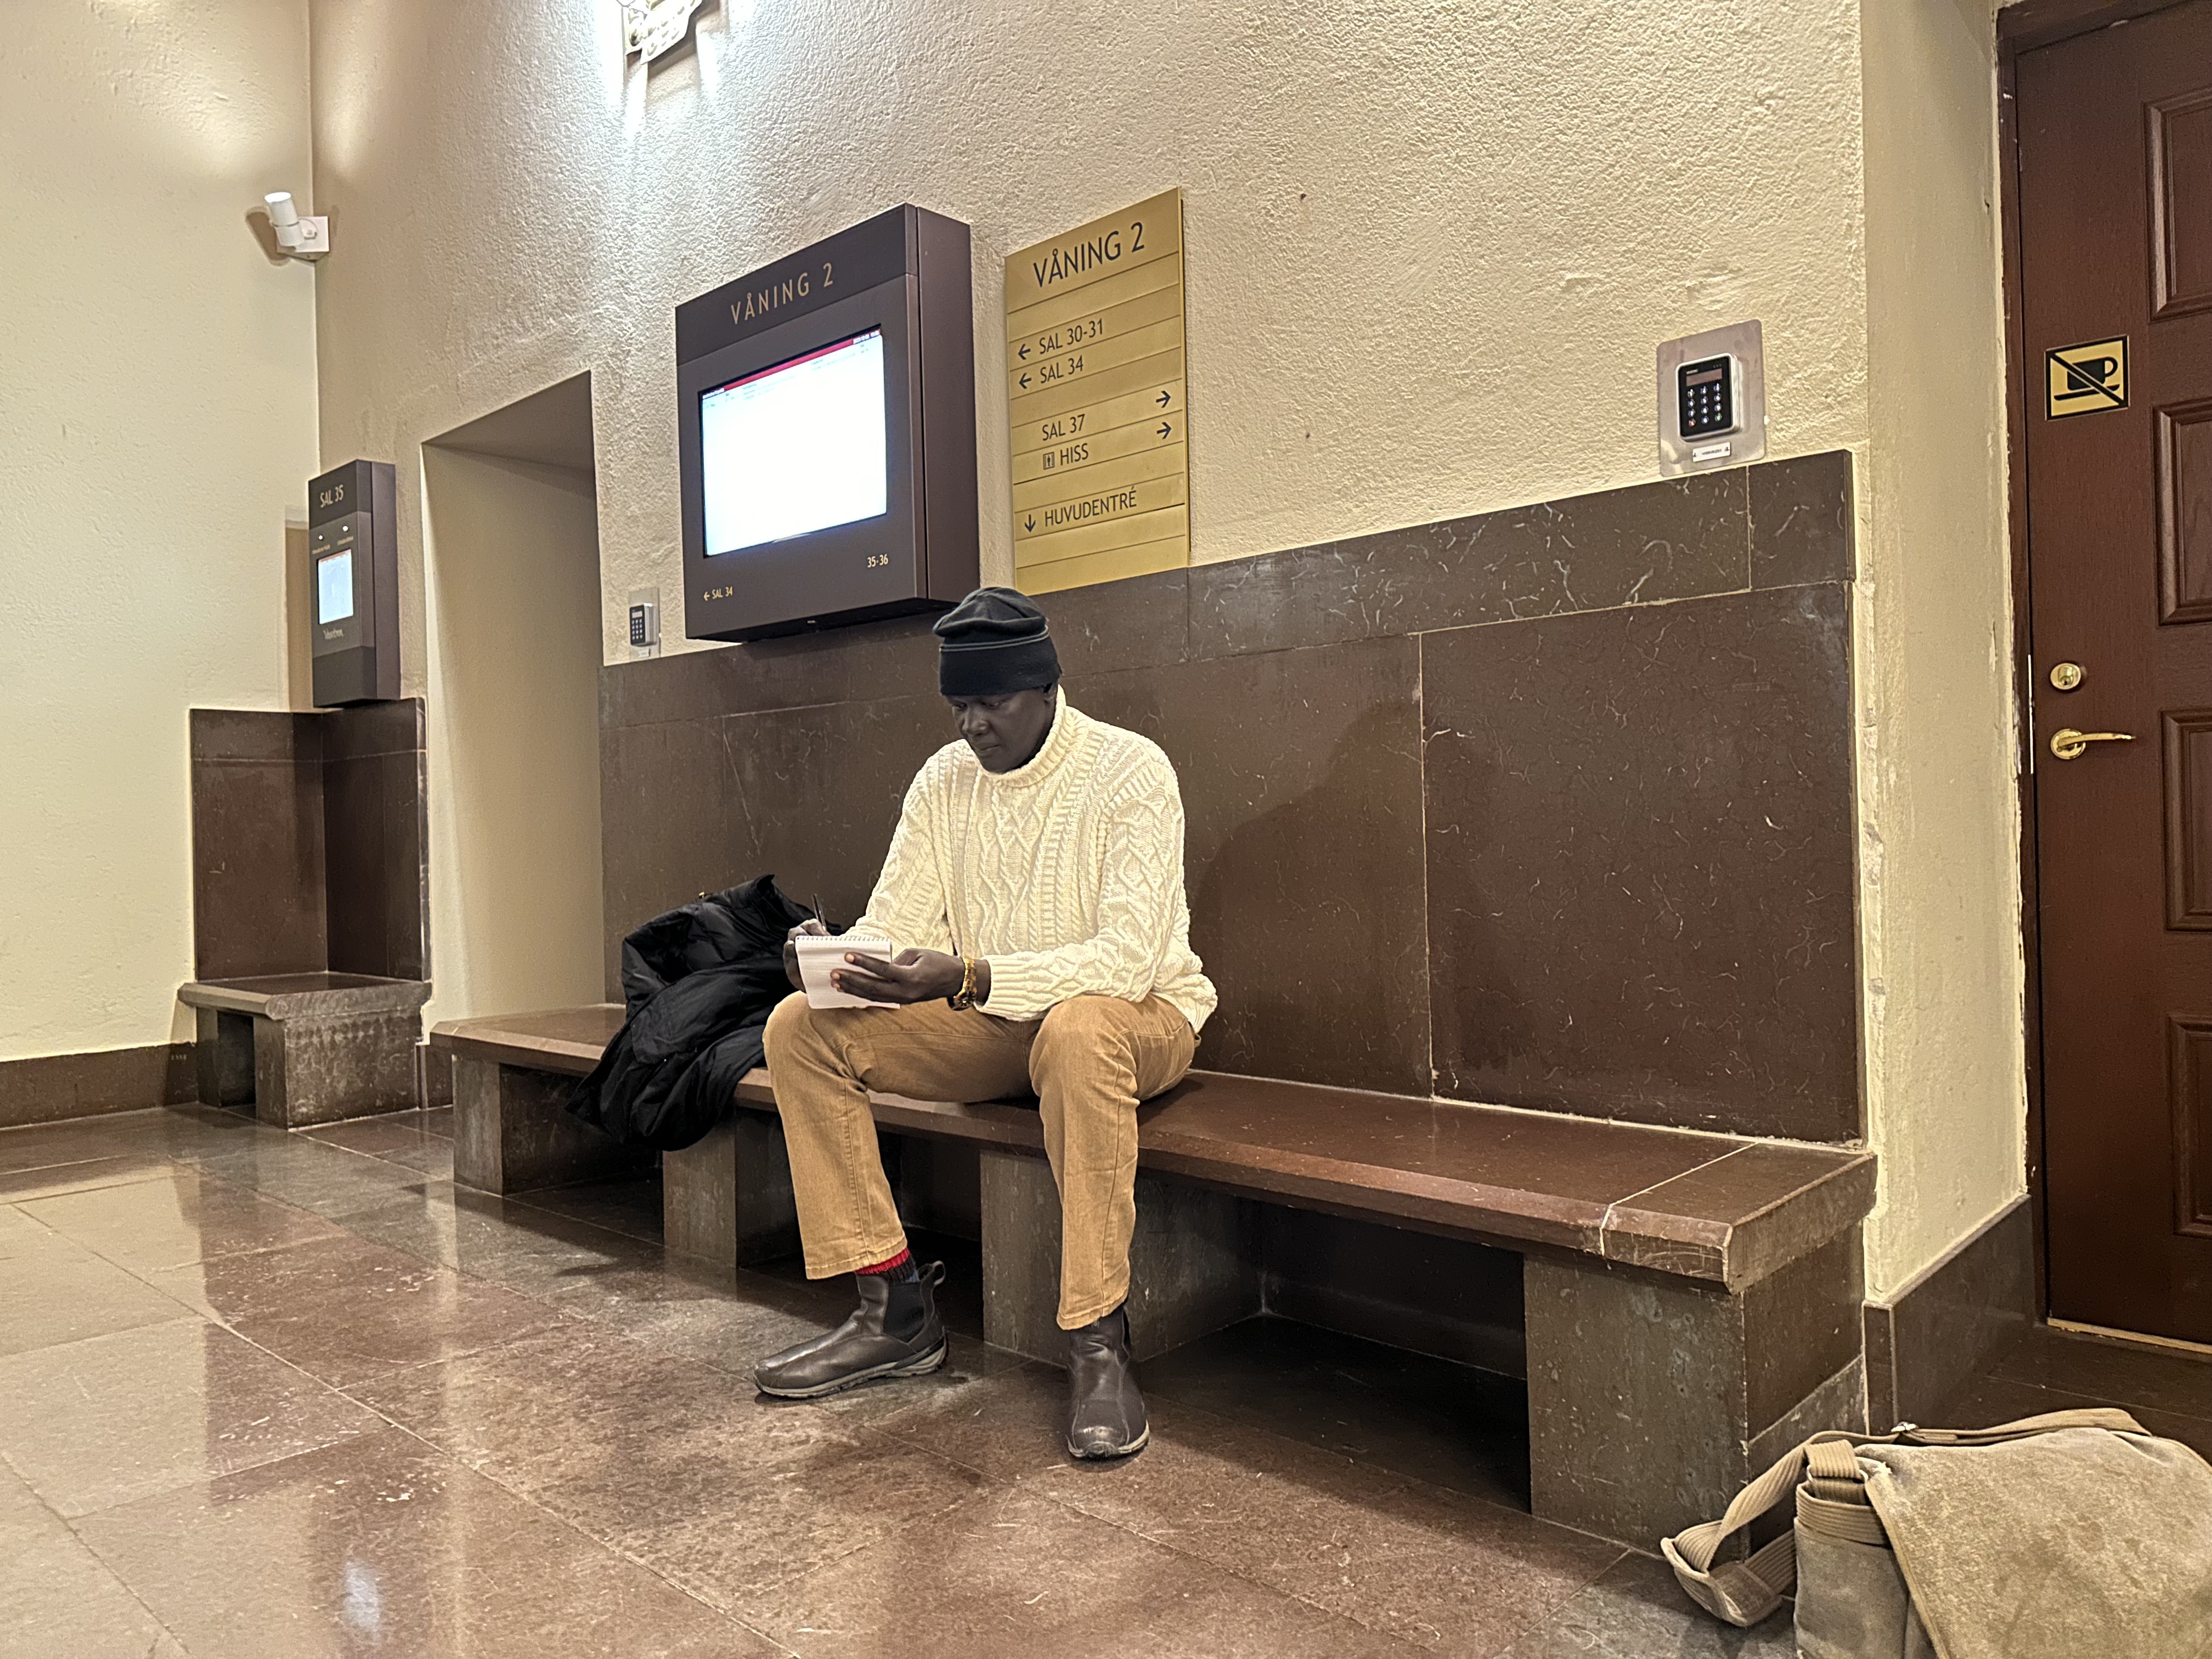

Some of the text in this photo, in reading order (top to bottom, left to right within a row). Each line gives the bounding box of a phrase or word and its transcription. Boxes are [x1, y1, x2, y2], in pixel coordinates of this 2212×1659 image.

[1032, 222, 1144, 288] VÅNING 2
[731, 262, 833, 325] VÅNING 2
[1039, 318, 1103, 354] SAL 30-31
[1040, 354, 1084, 384] SAL 34
[1042, 413, 1086, 441] SAL 37
[1059, 443, 1089, 466] HISS
[320, 484, 343, 508] SAL 35
[1045, 485, 1137, 527] HUVUDENTRÉ
[867, 554, 889, 568] 35-36
[712, 586, 733, 599] SAL 34
